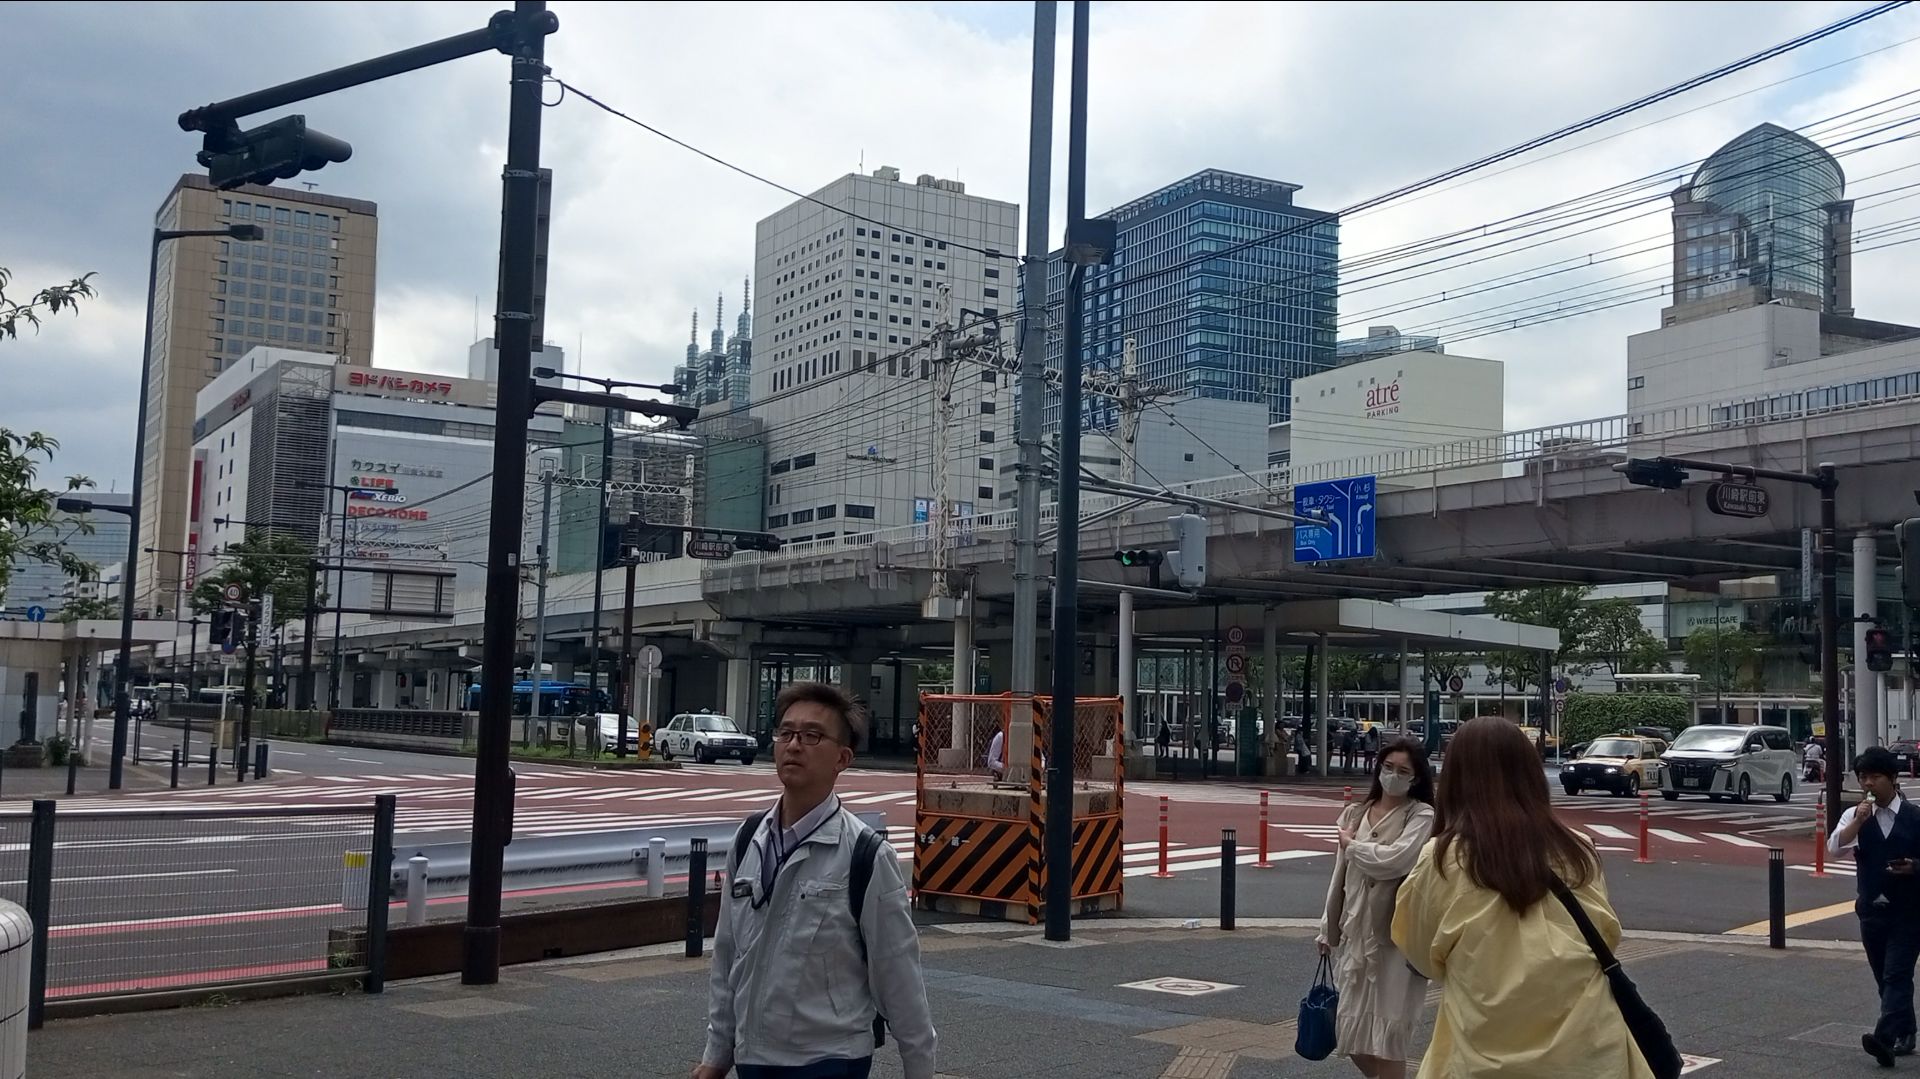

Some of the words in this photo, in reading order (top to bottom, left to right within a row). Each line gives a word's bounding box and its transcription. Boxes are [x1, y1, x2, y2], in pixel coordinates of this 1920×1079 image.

[348, 371, 452, 397] ヨドバシカメラ
[1366, 379, 1399, 407] atré
[1366, 406, 1399, 419] PARKING
[373, 492, 406, 503] XEBIO
[1722, 486, 1765, 504] 川崎駅前東
[639, 551, 668, 563] RONT
[229, 588, 238, 597] 40
